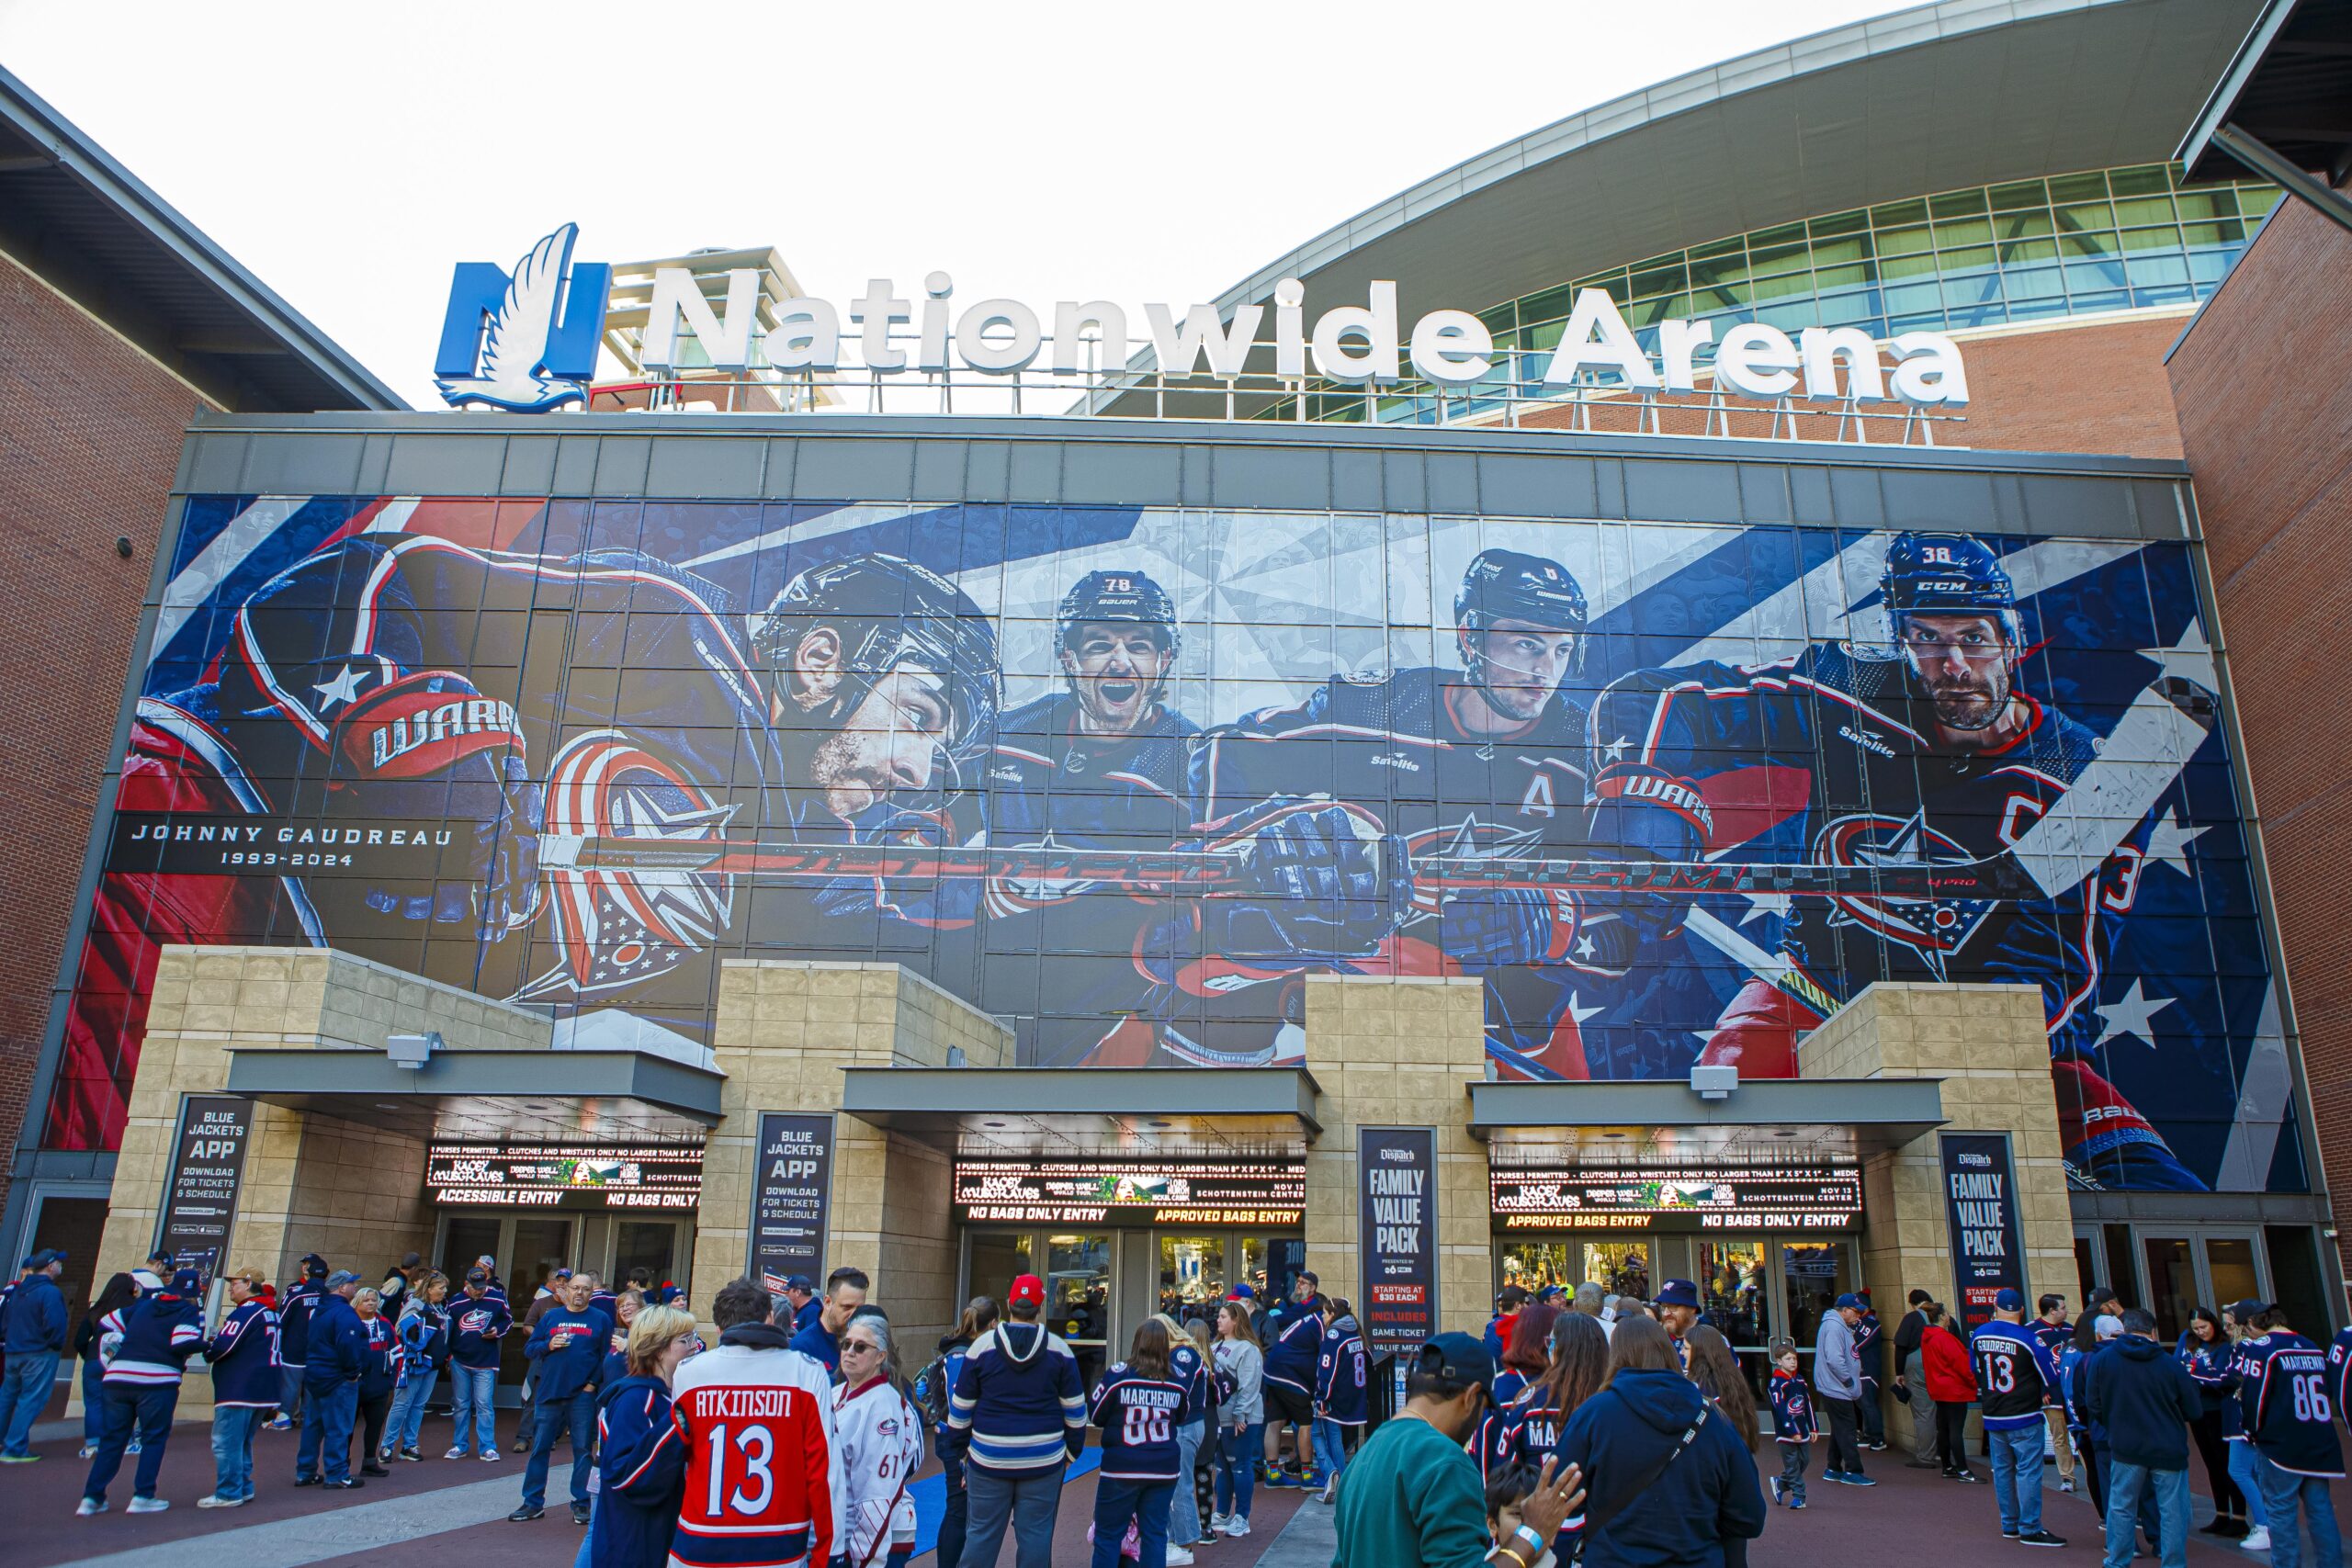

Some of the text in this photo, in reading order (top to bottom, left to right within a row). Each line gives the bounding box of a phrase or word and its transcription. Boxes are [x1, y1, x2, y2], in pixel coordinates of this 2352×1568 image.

[642, 267, 1970, 410] Nationwide Arena
[1922, 547, 1951, 564] 38
[1105, 579, 1130, 592] 78
[1917, 581, 1966, 591] CCM
[1838, 726, 1895, 759] Safelite
[1371, 756, 1419, 772] Safelite
[1517, 772, 1556, 818] A
[131, 825, 452, 846] JOHNNY GAUDREAU
[220, 852, 353, 866] 1993-2024
[204, 1111, 234, 1123] BLUE
[188, 1124, 244, 1136] JACKETS
[781, 1131, 813, 1143] BLUE
[189, 1140, 236, 1159] APP
[767, 1144, 824, 1156] JACKETS
[1380, 1148, 1415, 1161] Dispatch
[1959, 1154, 1992, 1166] Dispatch
[183, 1167, 234, 1177] DOWNLOAD
[771, 1159, 818, 1179] APP
[178, 1178, 235, 1188] FOR TICKETS
[1369, 1169, 1424, 1195] FAMILY
[1951, 1174, 2002, 1199] FAMILY
[176, 1190, 232, 1199] & SCHEDULE
[436, 1190, 563, 1204] ACCESSIBLE ENTRY
[766, 1186, 819, 1197] DOWNLOAD
[607, 1193, 696, 1206] NO BAGS ONLY
[762, 1198, 820, 1208] FOR TICKETS
[763, 1210, 818, 1219] & SCHEDULE
[968, 1206, 1107, 1221] NO BAGS ONLY ENTRY
[1155, 1210, 1300, 1223] APPROVED BAGS ENTRY
[1374, 1198, 1421, 1224] VALUE
[1957, 1201, 2005, 1227] VALUE
[1507, 1215, 1651, 1227] APPROVED BAGS ENTRY
[1702, 1214, 1849, 1226] NO BAGS ONLY ENTRY
[1376, 1226, 1419, 1254] PACK
[1962, 1230, 2006, 1257] PACK
[1380, 1293, 1394, 1302] $30
[1372, 1312, 1427, 1322] INCLUDES
[1373, 1328, 1396, 1337] GAME
[1977, 1340, 2017, 1355] GAUDREAU
[1321, 1354, 1330, 1368] 8
[1354, 1352, 1366, 1388] 8
[1984, 1353, 2016, 1393] 13
[695, 1390, 791, 1417] ATKINSON
[1120, 1387, 1181, 1409] MARCHENKO
[2293, 1374, 2331, 1422] 86
[1123, 1405, 1170, 1447] 86
[706, 1424, 775, 1517] 13
[878, 1454, 899, 1479] 61
